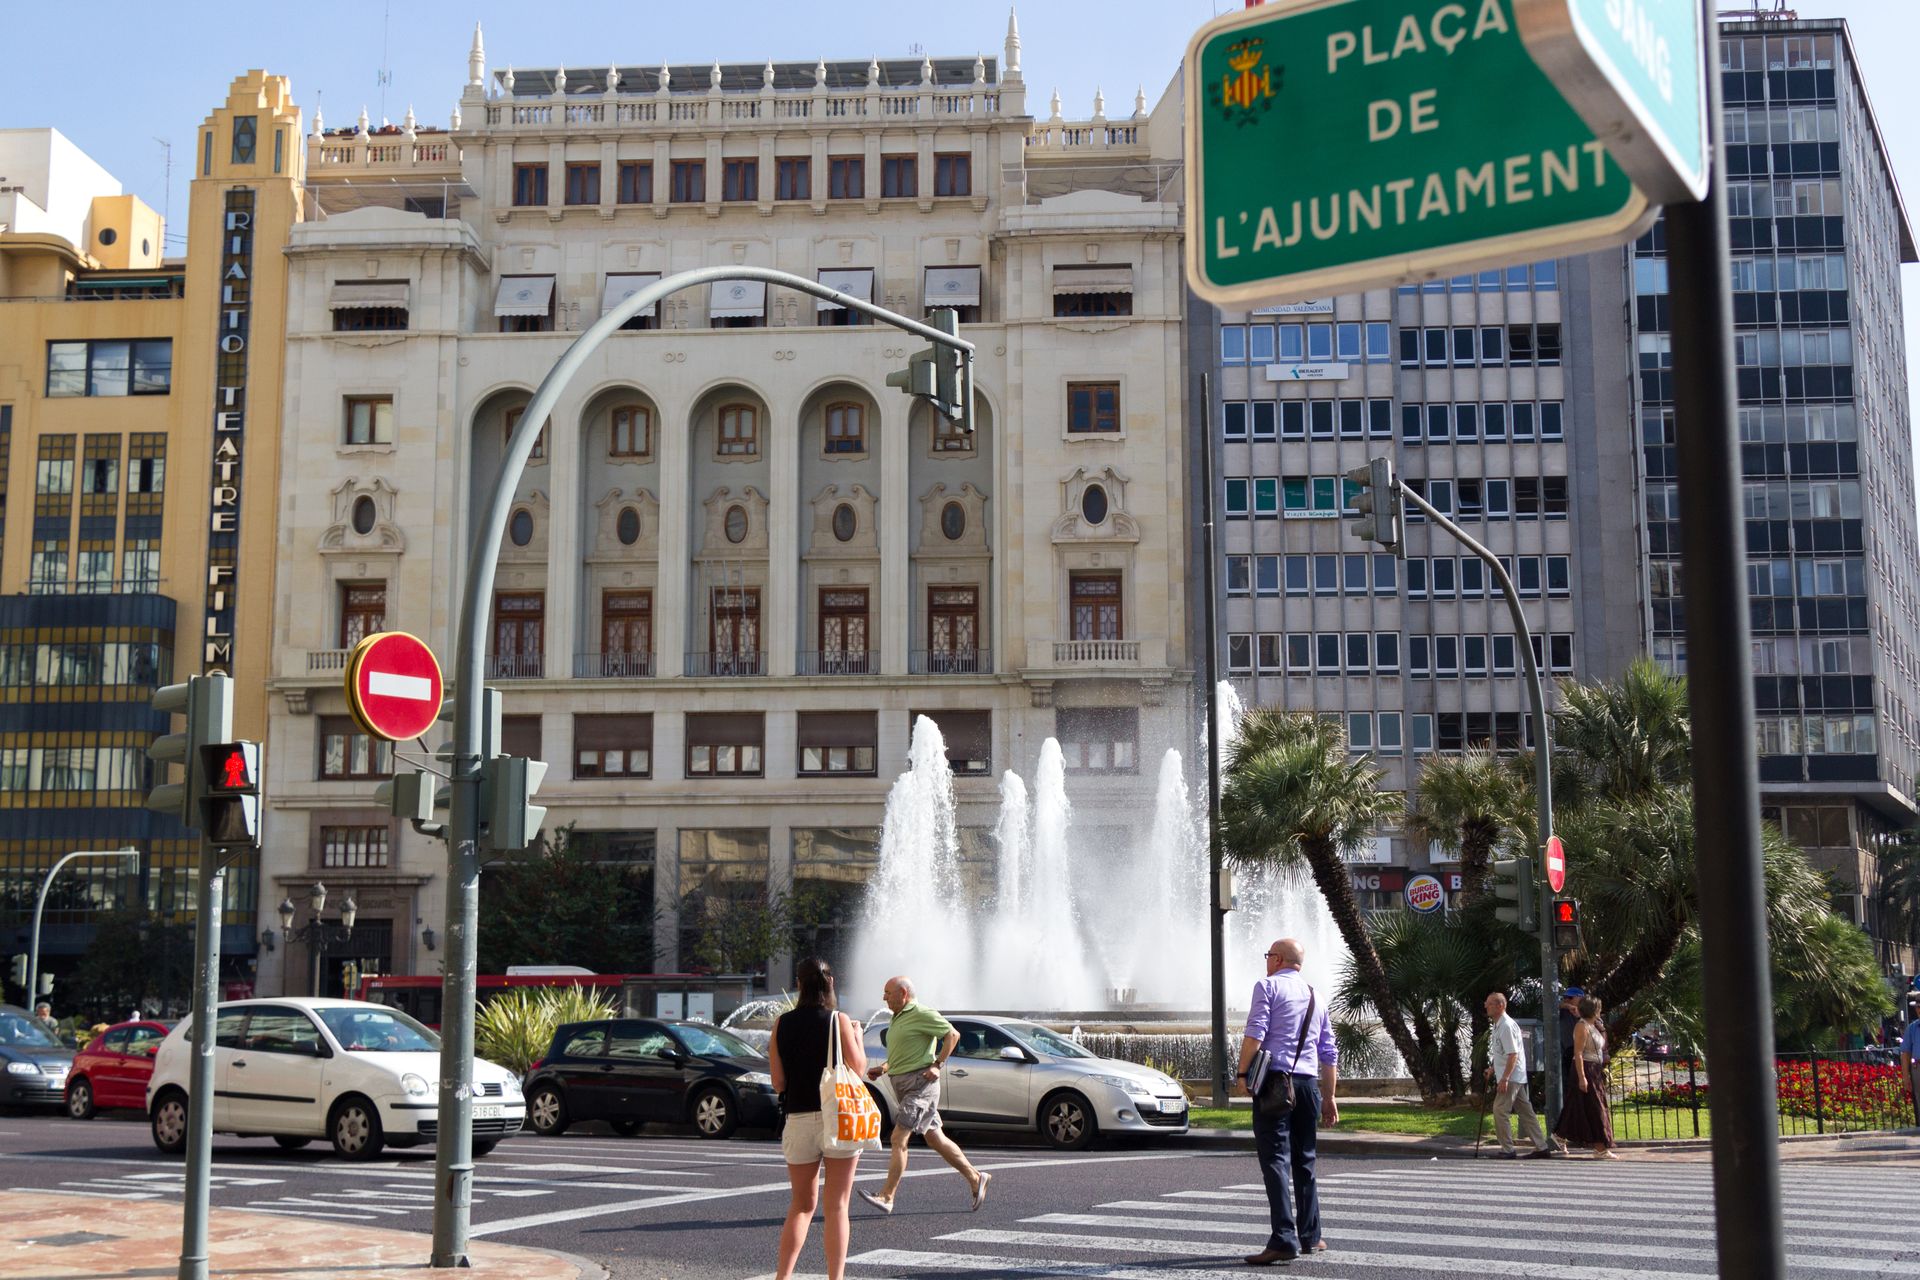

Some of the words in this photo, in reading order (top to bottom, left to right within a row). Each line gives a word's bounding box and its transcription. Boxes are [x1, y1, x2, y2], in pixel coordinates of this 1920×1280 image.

[1327, 0, 1508, 74] PLAÇA
[1368, 89, 1439, 142] DE
[1216, 142, 1611, 260] L'AJUNTAMENT
[221, 211, 251, 354] RIALTO
[212, 387, 242, 532] TEATRE
[1409, 883, 1439, 897] BURGER
[1411, 890, 1440, 906] KING
[838, 1099, 861, 1114] ARE
[838, 1112, 881, 1142] BAG
